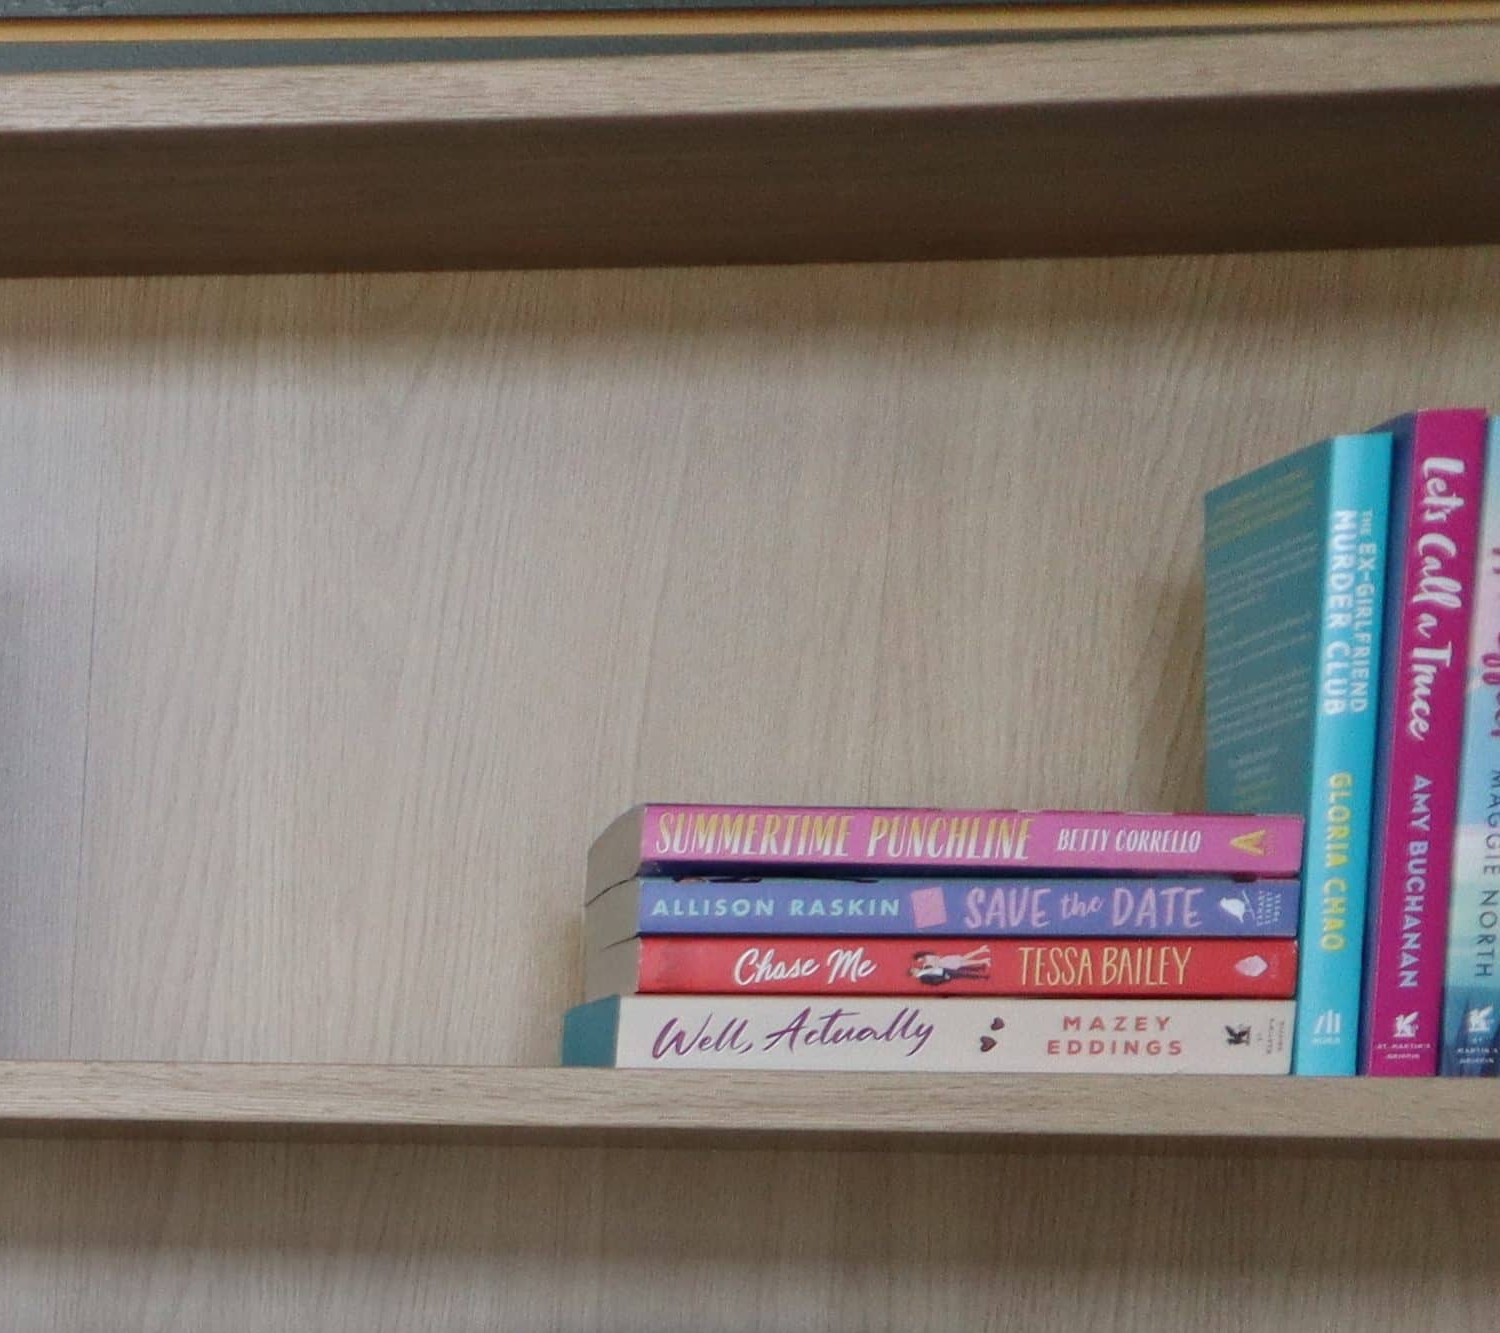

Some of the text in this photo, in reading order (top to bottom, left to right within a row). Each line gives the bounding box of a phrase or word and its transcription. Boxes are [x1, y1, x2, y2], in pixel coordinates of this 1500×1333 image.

[655, 813, 1202, 862] SUMMERTIME PUNCHLINE BETTY CORRELLO
[1320, 771, 1352, 954] GLORIA CHAO
[650, 887, 1205, 929] ALLISON RASKIN SAVE the DATE
[733, 948, 1191, 987] Chase Me TESSA BAILEY
[1061, 1015, 1173, 1033] MAZEY
[1045, 1038, 1184, 1055] EDDINGS
